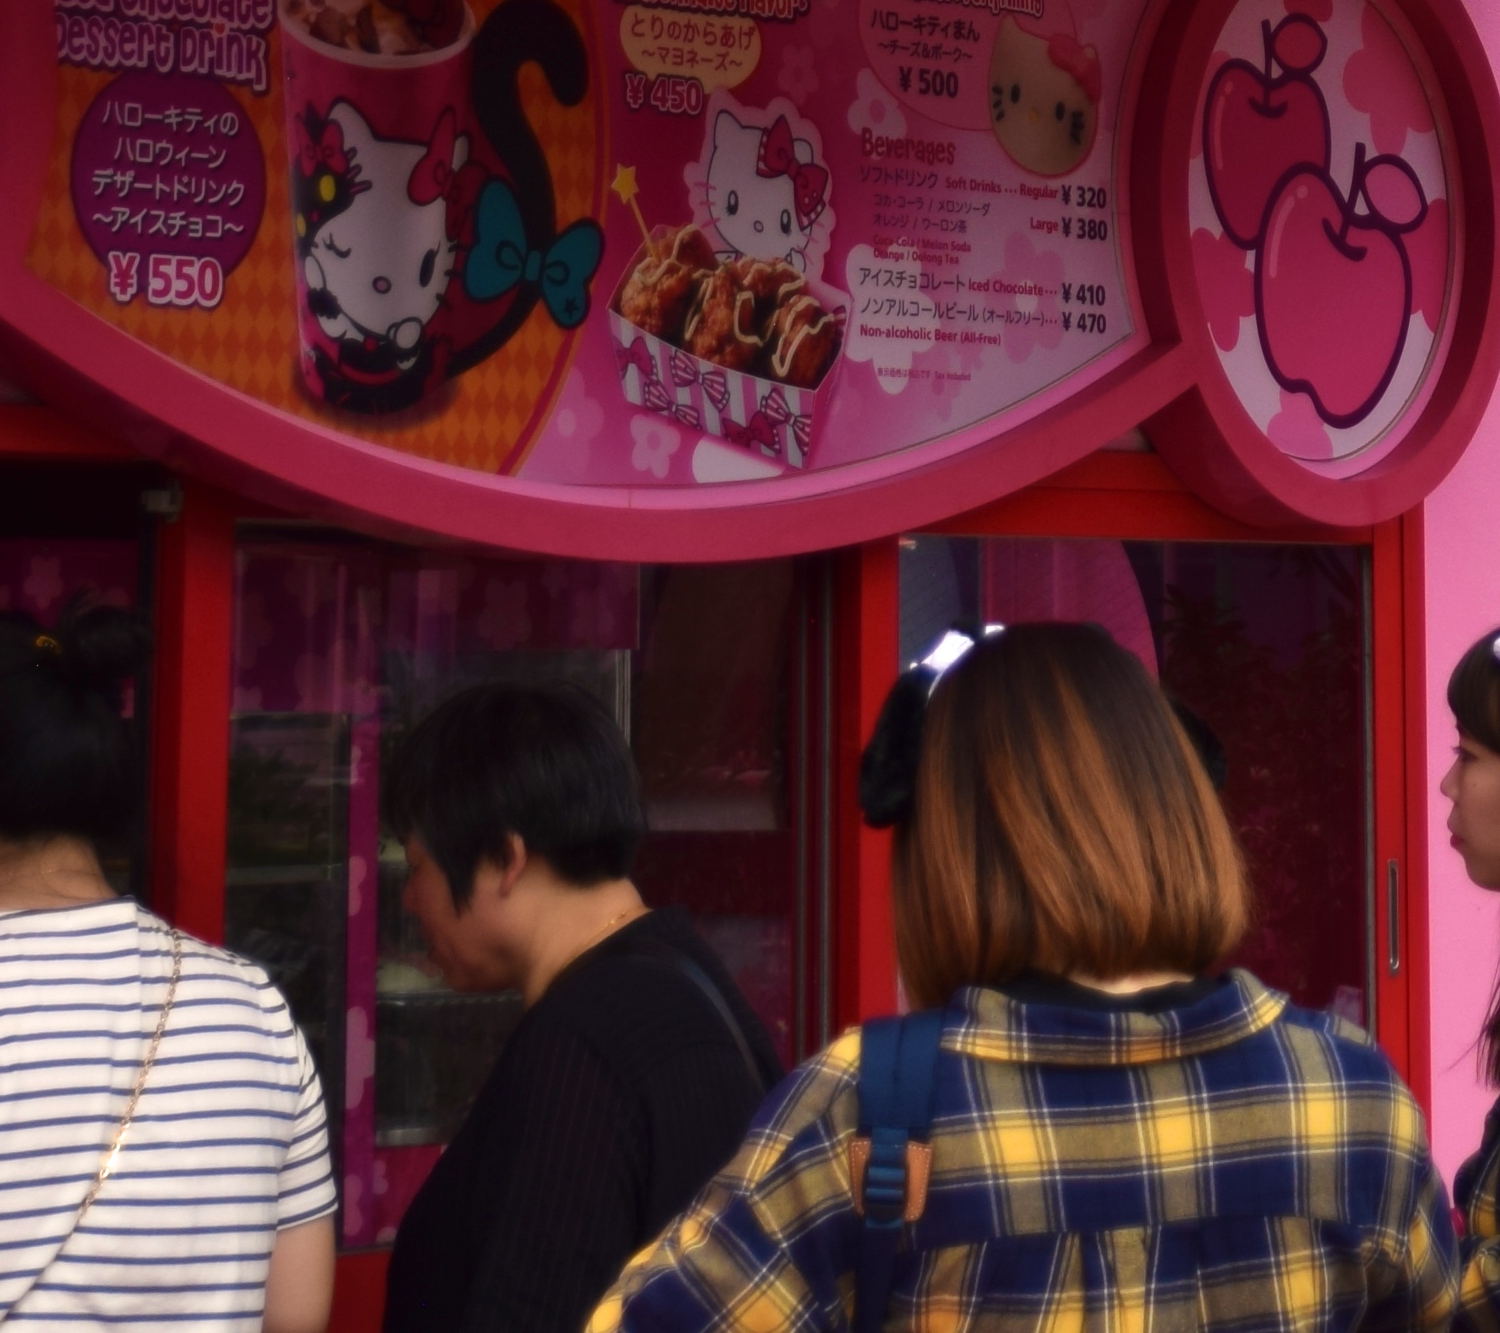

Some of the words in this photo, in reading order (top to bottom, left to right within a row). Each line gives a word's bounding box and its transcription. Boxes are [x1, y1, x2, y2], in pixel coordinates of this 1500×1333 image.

[631, 12, 757, 51] とりのからあげ
[871, 10, 980, 42] ハローキティまん
[180, 23, 267, 91] Drink
[102, 100, 239, 136] ハローキティの
[114, 136, 227, 168] ハロウィーン
[861, 127, 957, 166] Beverages
[92, 168, 245, 206] デザートドリンク
[860, 166, 939, 188] ソフトドリンク
[945, 178, 967, 192] Soft
[969, 179, 1002, 194] Drinks
[1020, 185, 1059, 200] Regular
[1030, 217, 1059, 232] Large
[945, 254, 959, 264] Tea
[951, 240, 972, 252] Soda
[859, 267, 965, 293] アイスチョコレート
[968, 277, 990, 291] Iced
[860, 324, 932, 340] Non-alcoholic
[934, 326, 958, 341] Beer
